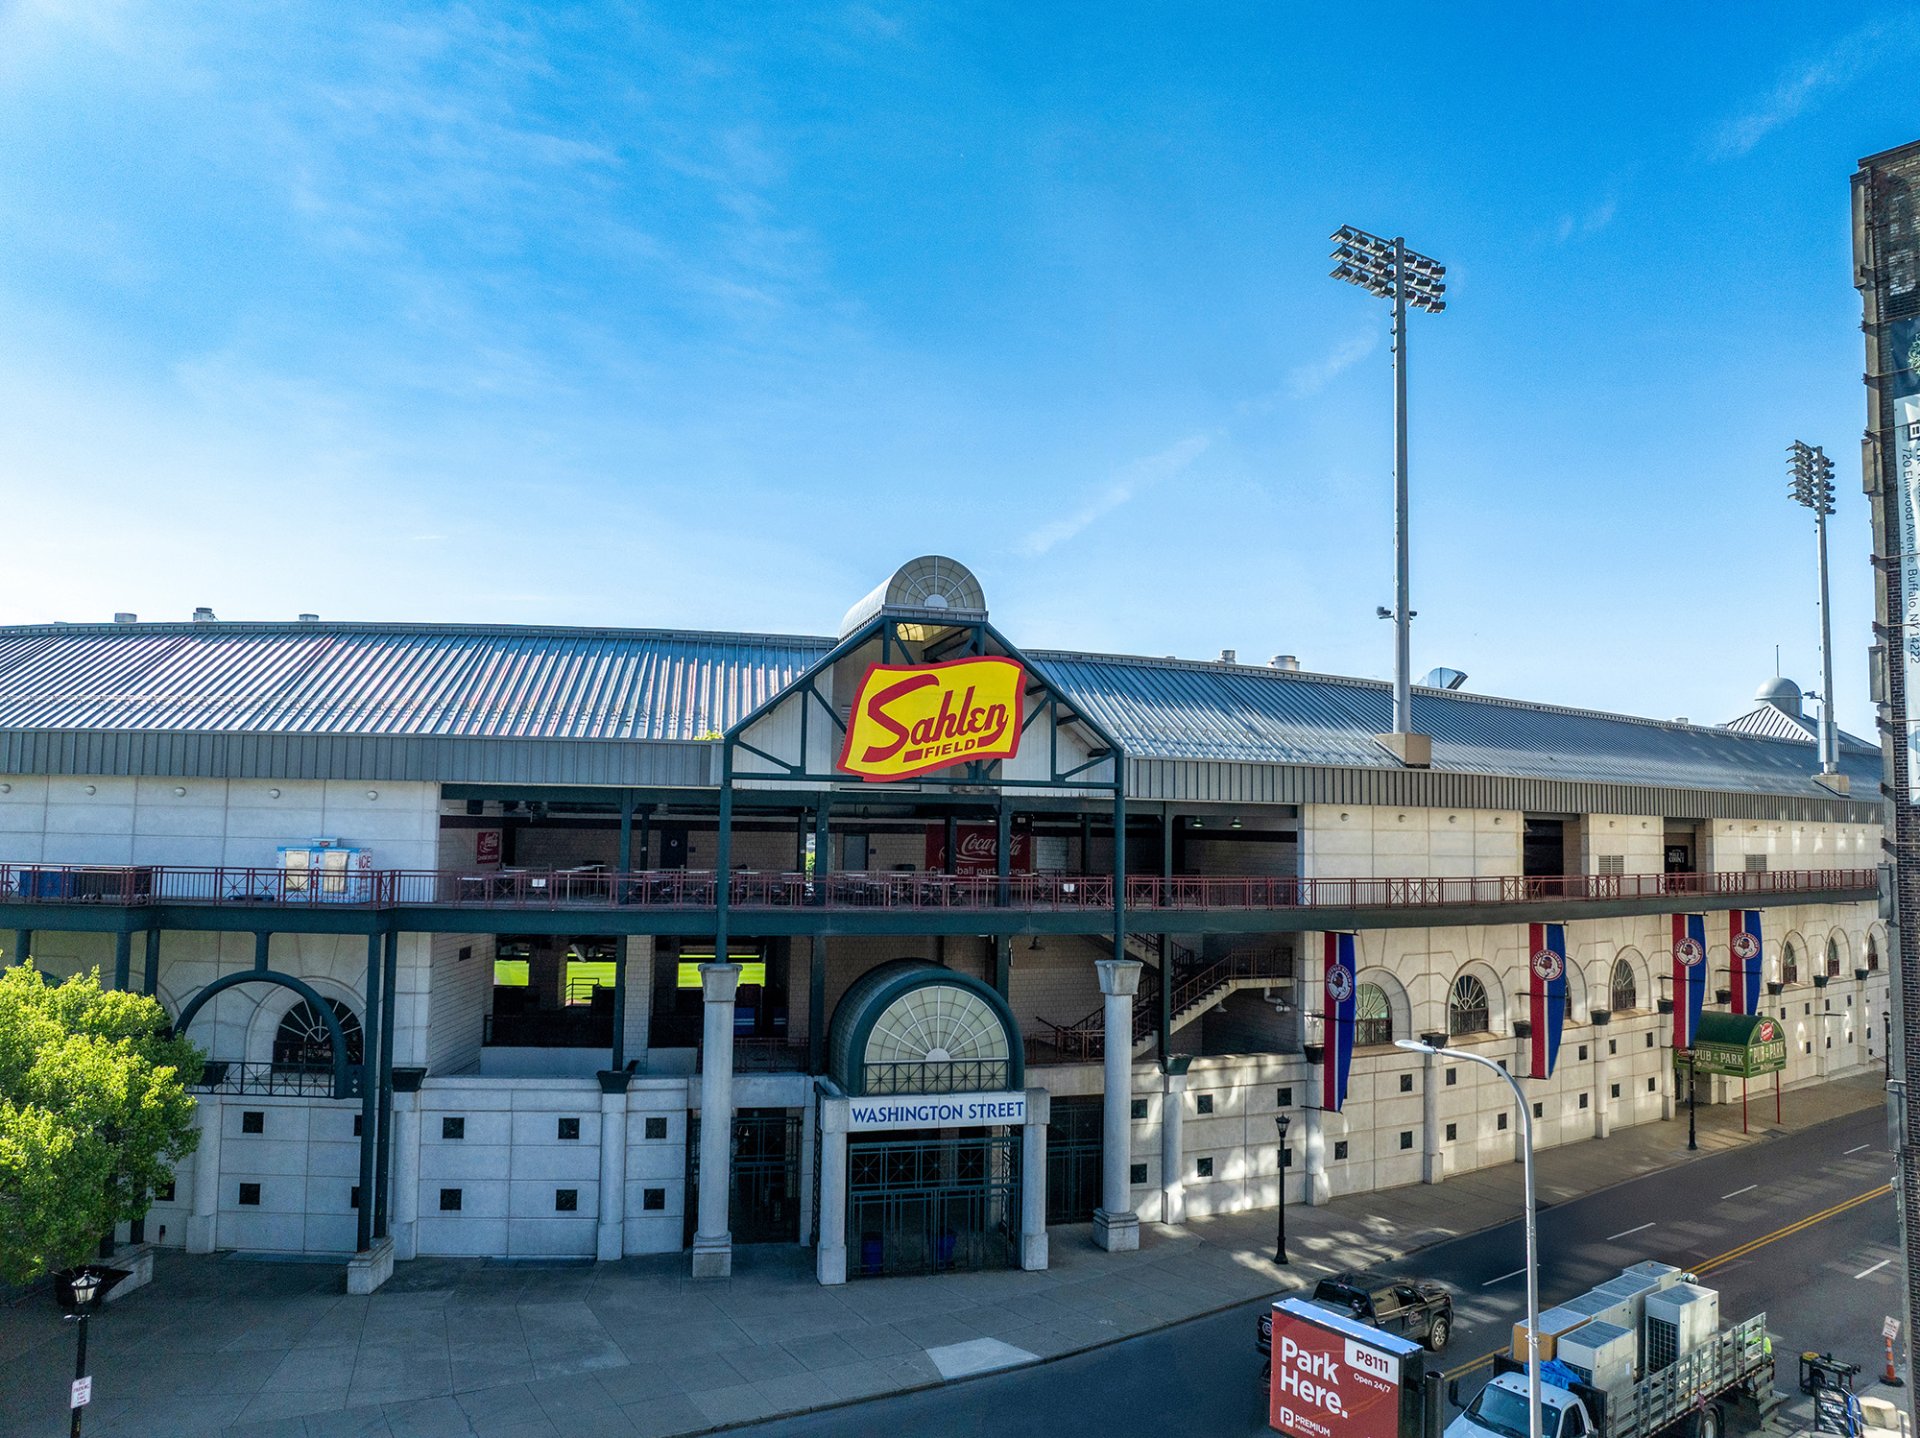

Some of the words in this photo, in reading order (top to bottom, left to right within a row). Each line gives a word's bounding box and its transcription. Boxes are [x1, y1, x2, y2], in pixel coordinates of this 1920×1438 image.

[1902, 447, 1912, 468] 720
[1903, 470, 1914, 520] Elmwood
[1909, 613, 1920, 630] NY
[1909, 632, 1920, 664] 14222
[861, 674, 1009, 763] Sahlen
[924, 737, 978, 759] FIELD
[1695, 1048, 1712, 1061] PUB
[1720, 1052, 1744, 1065] PARK
[1753, 1045, 1765, 1064] PUB
[1769, 1041, 1785, 1060] PARK
[852, 1103, 963, 1123] WASHINGTON
[968, 1101, 1024, 1119] STREET
[1281, 1336, 1339, 1385] Park
[1356, 1349, 1389, 1374] P8111
[1280, 1364, 1348, 1419] Here.
[1353, 1372, 1373, 1388] Open
[1373, 1380, 1391, 1394] 24/7
[1294, 1414, 1331, 1437] PREMIUM
